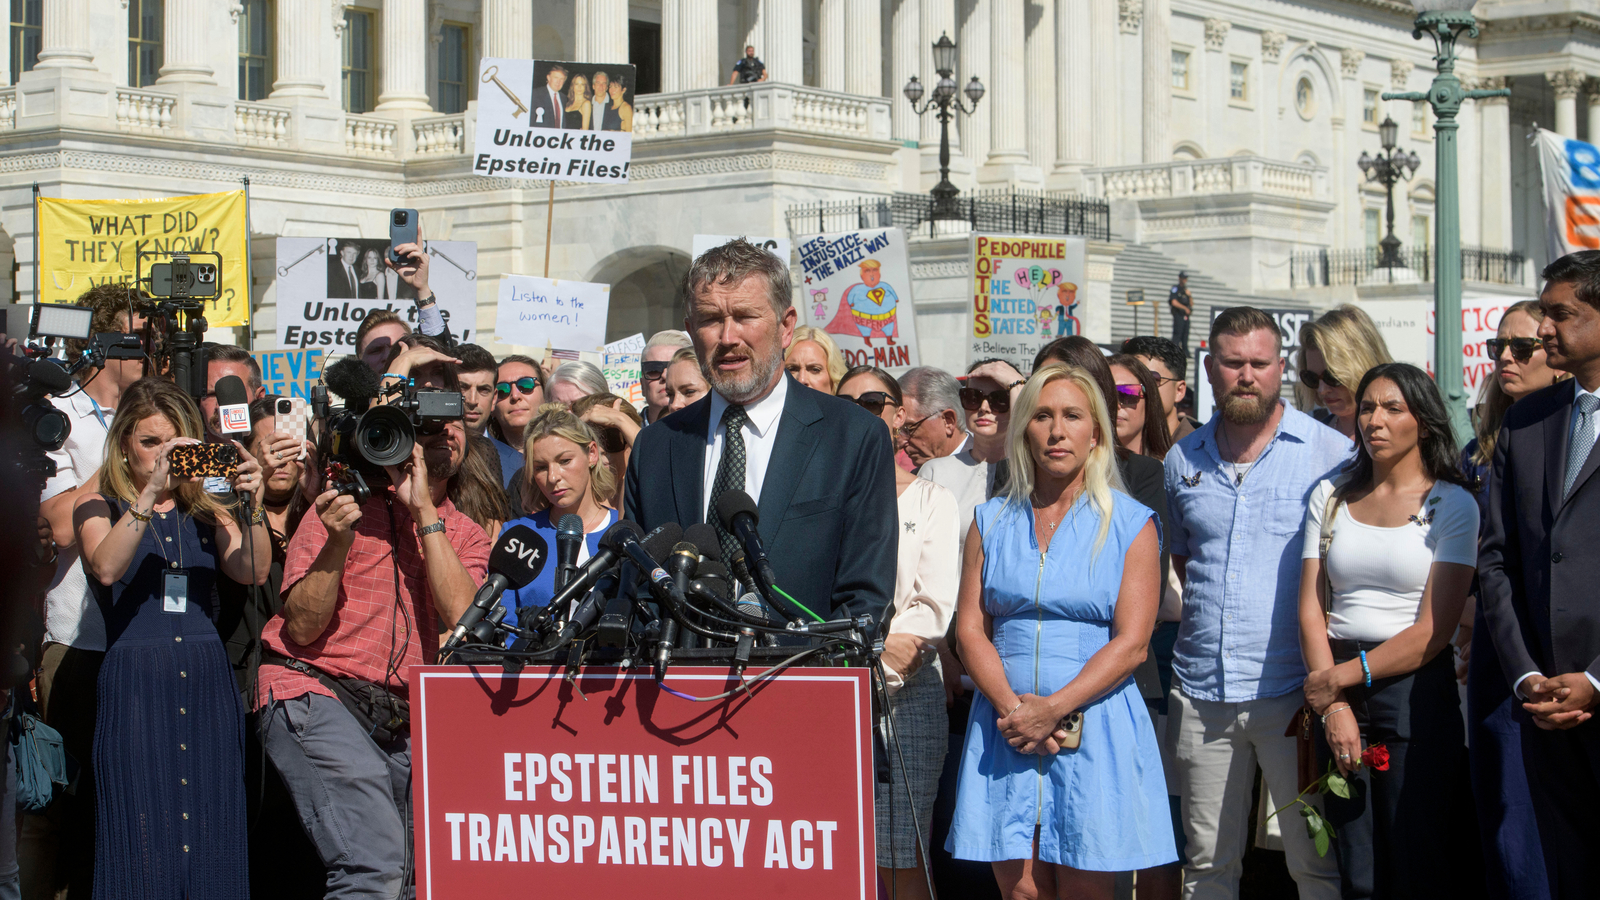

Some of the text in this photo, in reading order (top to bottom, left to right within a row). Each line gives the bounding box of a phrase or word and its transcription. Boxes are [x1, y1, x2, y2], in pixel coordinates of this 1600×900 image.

[493, 128, 615, 152] Unlock the
[475, 153, 630, 179] Epstein Files!
[89, 211, 198, 236] WHAT DID
[65, 227, 220, 263] THEY KNOW?
[812, 261, 835, 282] THE
[833, 246, 865, 272] NAZI
[863, 231, 890, 254] WAY
[1017, 268, 1061, 286] HELP
[511, 285, 584, 309] Listen to the
[872, 289, 883, 305] P
[407, 304, 450, 322] te
[1375, 316, 1416, 328] ardians
[284, 325, 357, 349] Epste
[603, 335, 645, 354] ELEASE
[1018, 343, 1036, 355] The
[841, 345, 910, 368] DO-MAN
[1463, 342, 1487, 357] or
[251, 349, 322, 381] IEVE
[504, 537, 542, 570] svt
[503, 752, 774, 807] EPSTEIN FILES
[444, 812, 838, 870] TRANSPARENCY ACT
